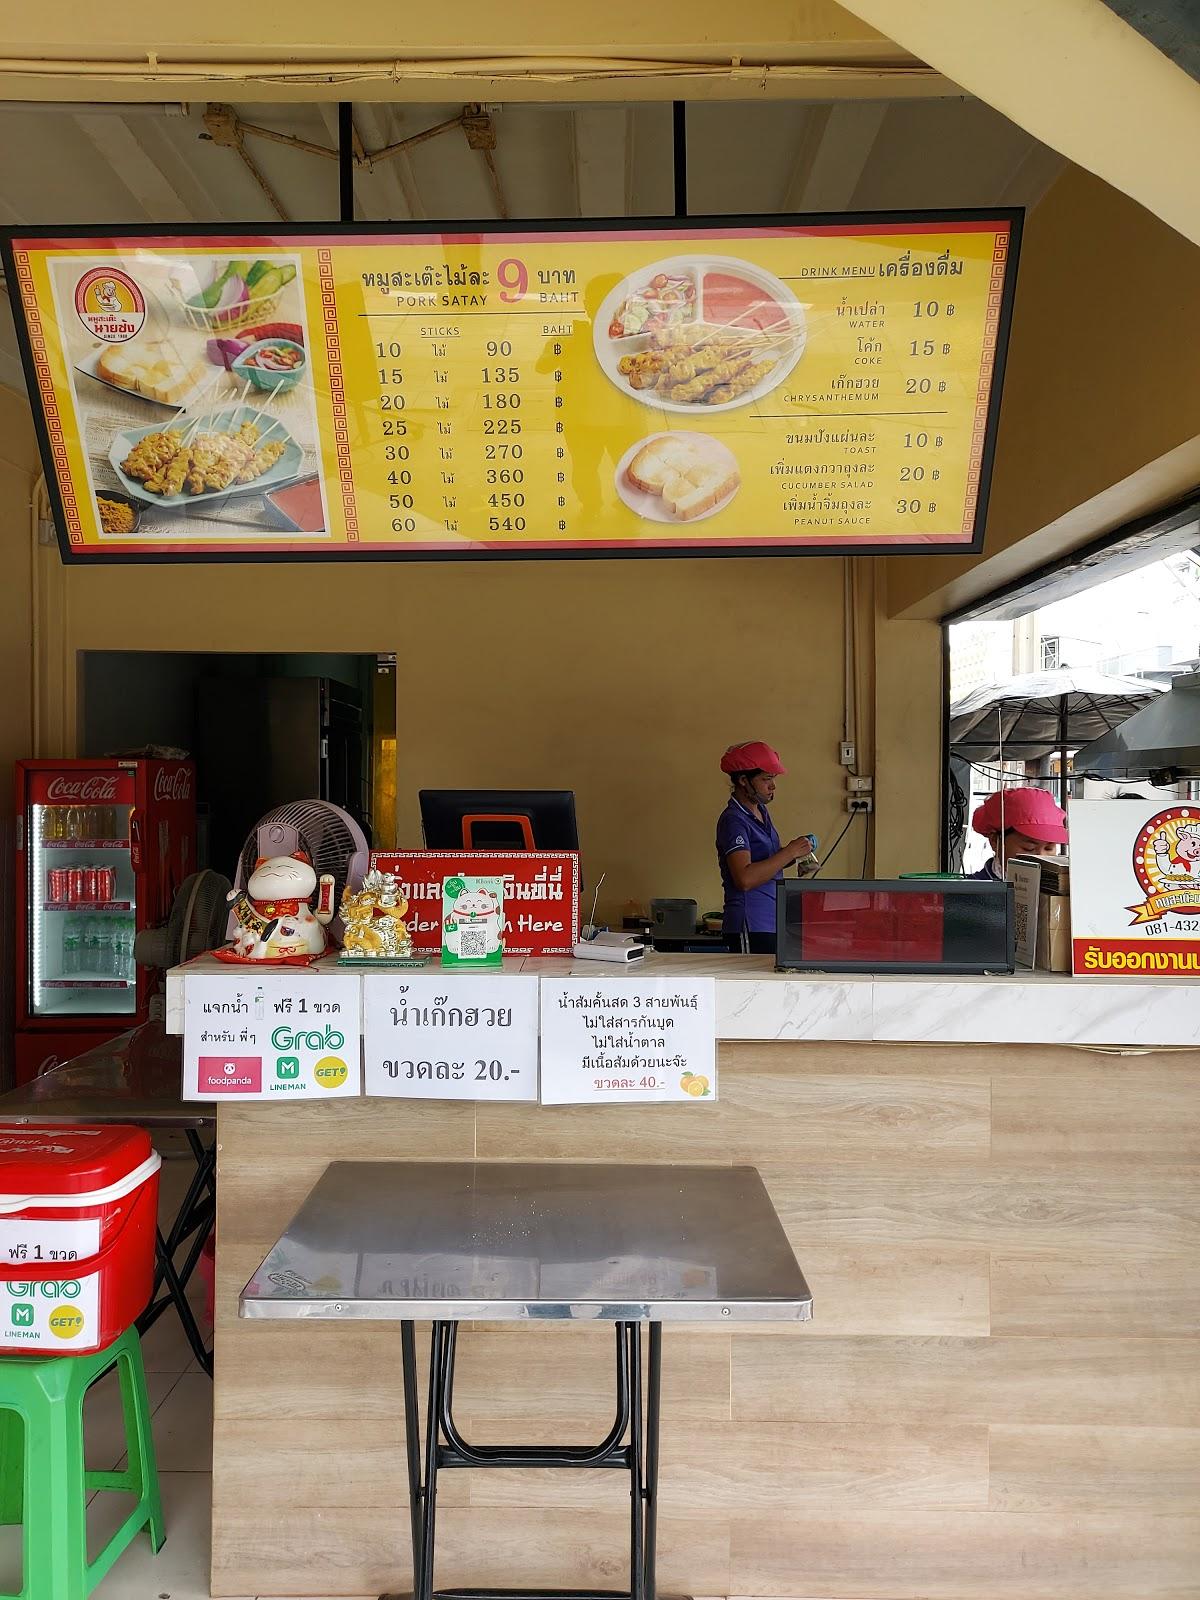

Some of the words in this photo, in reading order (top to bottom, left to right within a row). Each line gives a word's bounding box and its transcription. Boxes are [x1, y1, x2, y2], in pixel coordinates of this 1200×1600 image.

[801, 267, 837, 276] DRINK
[841, 266, 875, 276] MENU
[879, 249, 964, 277] เครื่องดื่ม
[362, 264, 490, 294] หมูสะเต๊ะไม้ละ
[497, 258, 529, 303] 9
[537, 269, 576, 285] บาท
[397, 295, 437, 307] PORK
[442, 295, 488, 307] SATAY
[539, 291, 579, 304] BAHT
[836, 296, 885, 316] น้ำเปล่า
[913, 301, 939, 318] 10
[420, 327, 460, 336] STICKS
[543, 325, 573, 335] BAHT
[849, 321, 885, 329] WATER
[377, 342, 401, 358] 10
[432, 343, 447, 357] ไม้
[486, 341, 512, 357] 90
[857, 337, 882, 353] โค้ก
[910, 340, 935, 356] 15
[854, 357, 882, 365] COKE
[378, 368, 403, 385] 15
[434, 369, 449, 384] ไม้
[481, 367, 521, 383] 135
[831, 374, 879, 389] เก๊กฮวย
[905, 378, 931, 394] 20
[380, 395, 406, 411] 20
[435, 396, 450, 409] ไม้
[482, 393, 521, 409] 180
[783, 393, 880, 402] CHRYSANTHEMUM
[382, 420, 407, 436] 25
[437, 421, 452, 435] ไม้
[483, 419, 522, 435] 225
[786, 428, 875, 444] ขนมปังแผ่นละ
[904, 433, 928, 449] 10
[385, 446, 410, 461] 30
[439, 447, 453, 460] ไม้
[485, 444, 523, 460] 270
[387, 470, 412, 485] 40
[441, 471, 455, 484] ไม้
[486, 469, 524, 484] 360
[770, 458, 875, 479] เพิ่มแตงกวาถุงละ
[900, 466, 925, 482] 20
[782, 482, 836, 490] CUCUMBER
[840, 481, 874, 489] SALAD
[389, 494, 414, 509] 50
[443, 495, 457, 509] ไม้
[487, 493, 525, 508] 450
[783, 493, 872, 515] เพิ่มน้ำจิ้มถุงละ
[896, 500, 921, 514] 30
[391, 518, 416, 532] 60
[444, 519, 458, 532] ไม้
[489, 517, 526, 531] 540
[838, 517, 871, 525] SAUCE
[404, 912, 439, 932] der
[518, 914, 564, 933] Here
[203, 992, 249, 1013] แจกน้ำ
[274, 998, 292, 1013] ฟรี
[299, 998, 308, 1013] 1
[313, 1003, 341, 1013] ขวด
[390, 985, 513, 1027] น้ำเก๊กฮวย
[558, 992, 628, 1009] น้ำส้มคั้นสด
[633, 996, 641, 1008] 3
[645, 994, 698, 1010] สายพันธุ์
[583, 1015, 674, 1030] ไม่ใส่สารกันบูด
[200, 1030, 235, 1043] สำหรับ
[271, 1024, 345, 1050] Grab
[592, 1032, 665, 1048] ไม่ใส่น้ำตาล
[582, 1052, 687, 1069] มีเนื้อส้มด้วยนะจ๊ะ
[383, 1059, 465, 1081] ขวดละ
[475, 1059, 520, 1081] 20.-
[208, 1076, 252, 1087] foodpanda
[594, 1078, 635, 1089] ขวดละ
[640, 1076, 665, 1088] 40.-
[9, 1244, 28, 1259] ฟรี
[34, 1245, 43, 1260] 1
[49, 1250, 78, 1260] ขวด
